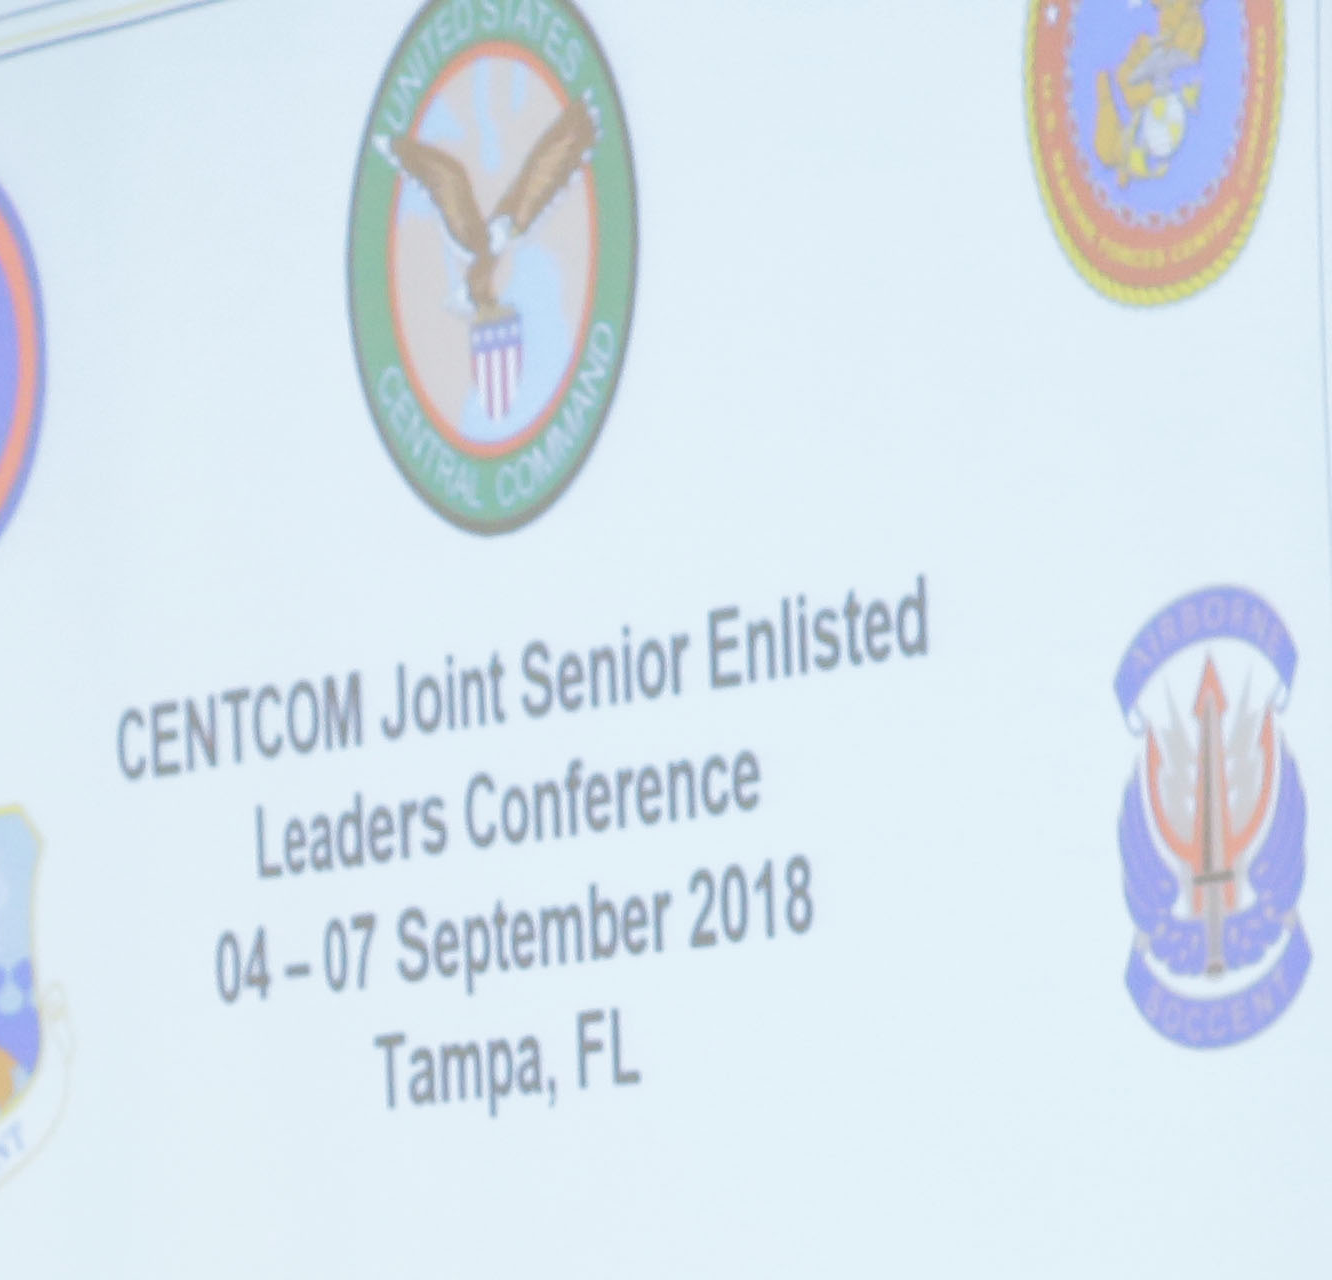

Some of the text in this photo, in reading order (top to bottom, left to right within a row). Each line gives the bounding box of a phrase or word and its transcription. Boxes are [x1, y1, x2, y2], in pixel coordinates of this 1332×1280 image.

[378, 321, 616, 508] CENTRAL COMMAND
[116, 573, 929, 782] CENTCOM Joint Senior Enlisted
[255, 749, 762, 880] Leaders Conference
[215, 925, 273, 1005] 04
[323, 911, 378, 994] 07
[396, 882, 673, 997] September
[688, 853, 815, 949] 2018
[372, 1007, 643, 1118] Tampa, FL
